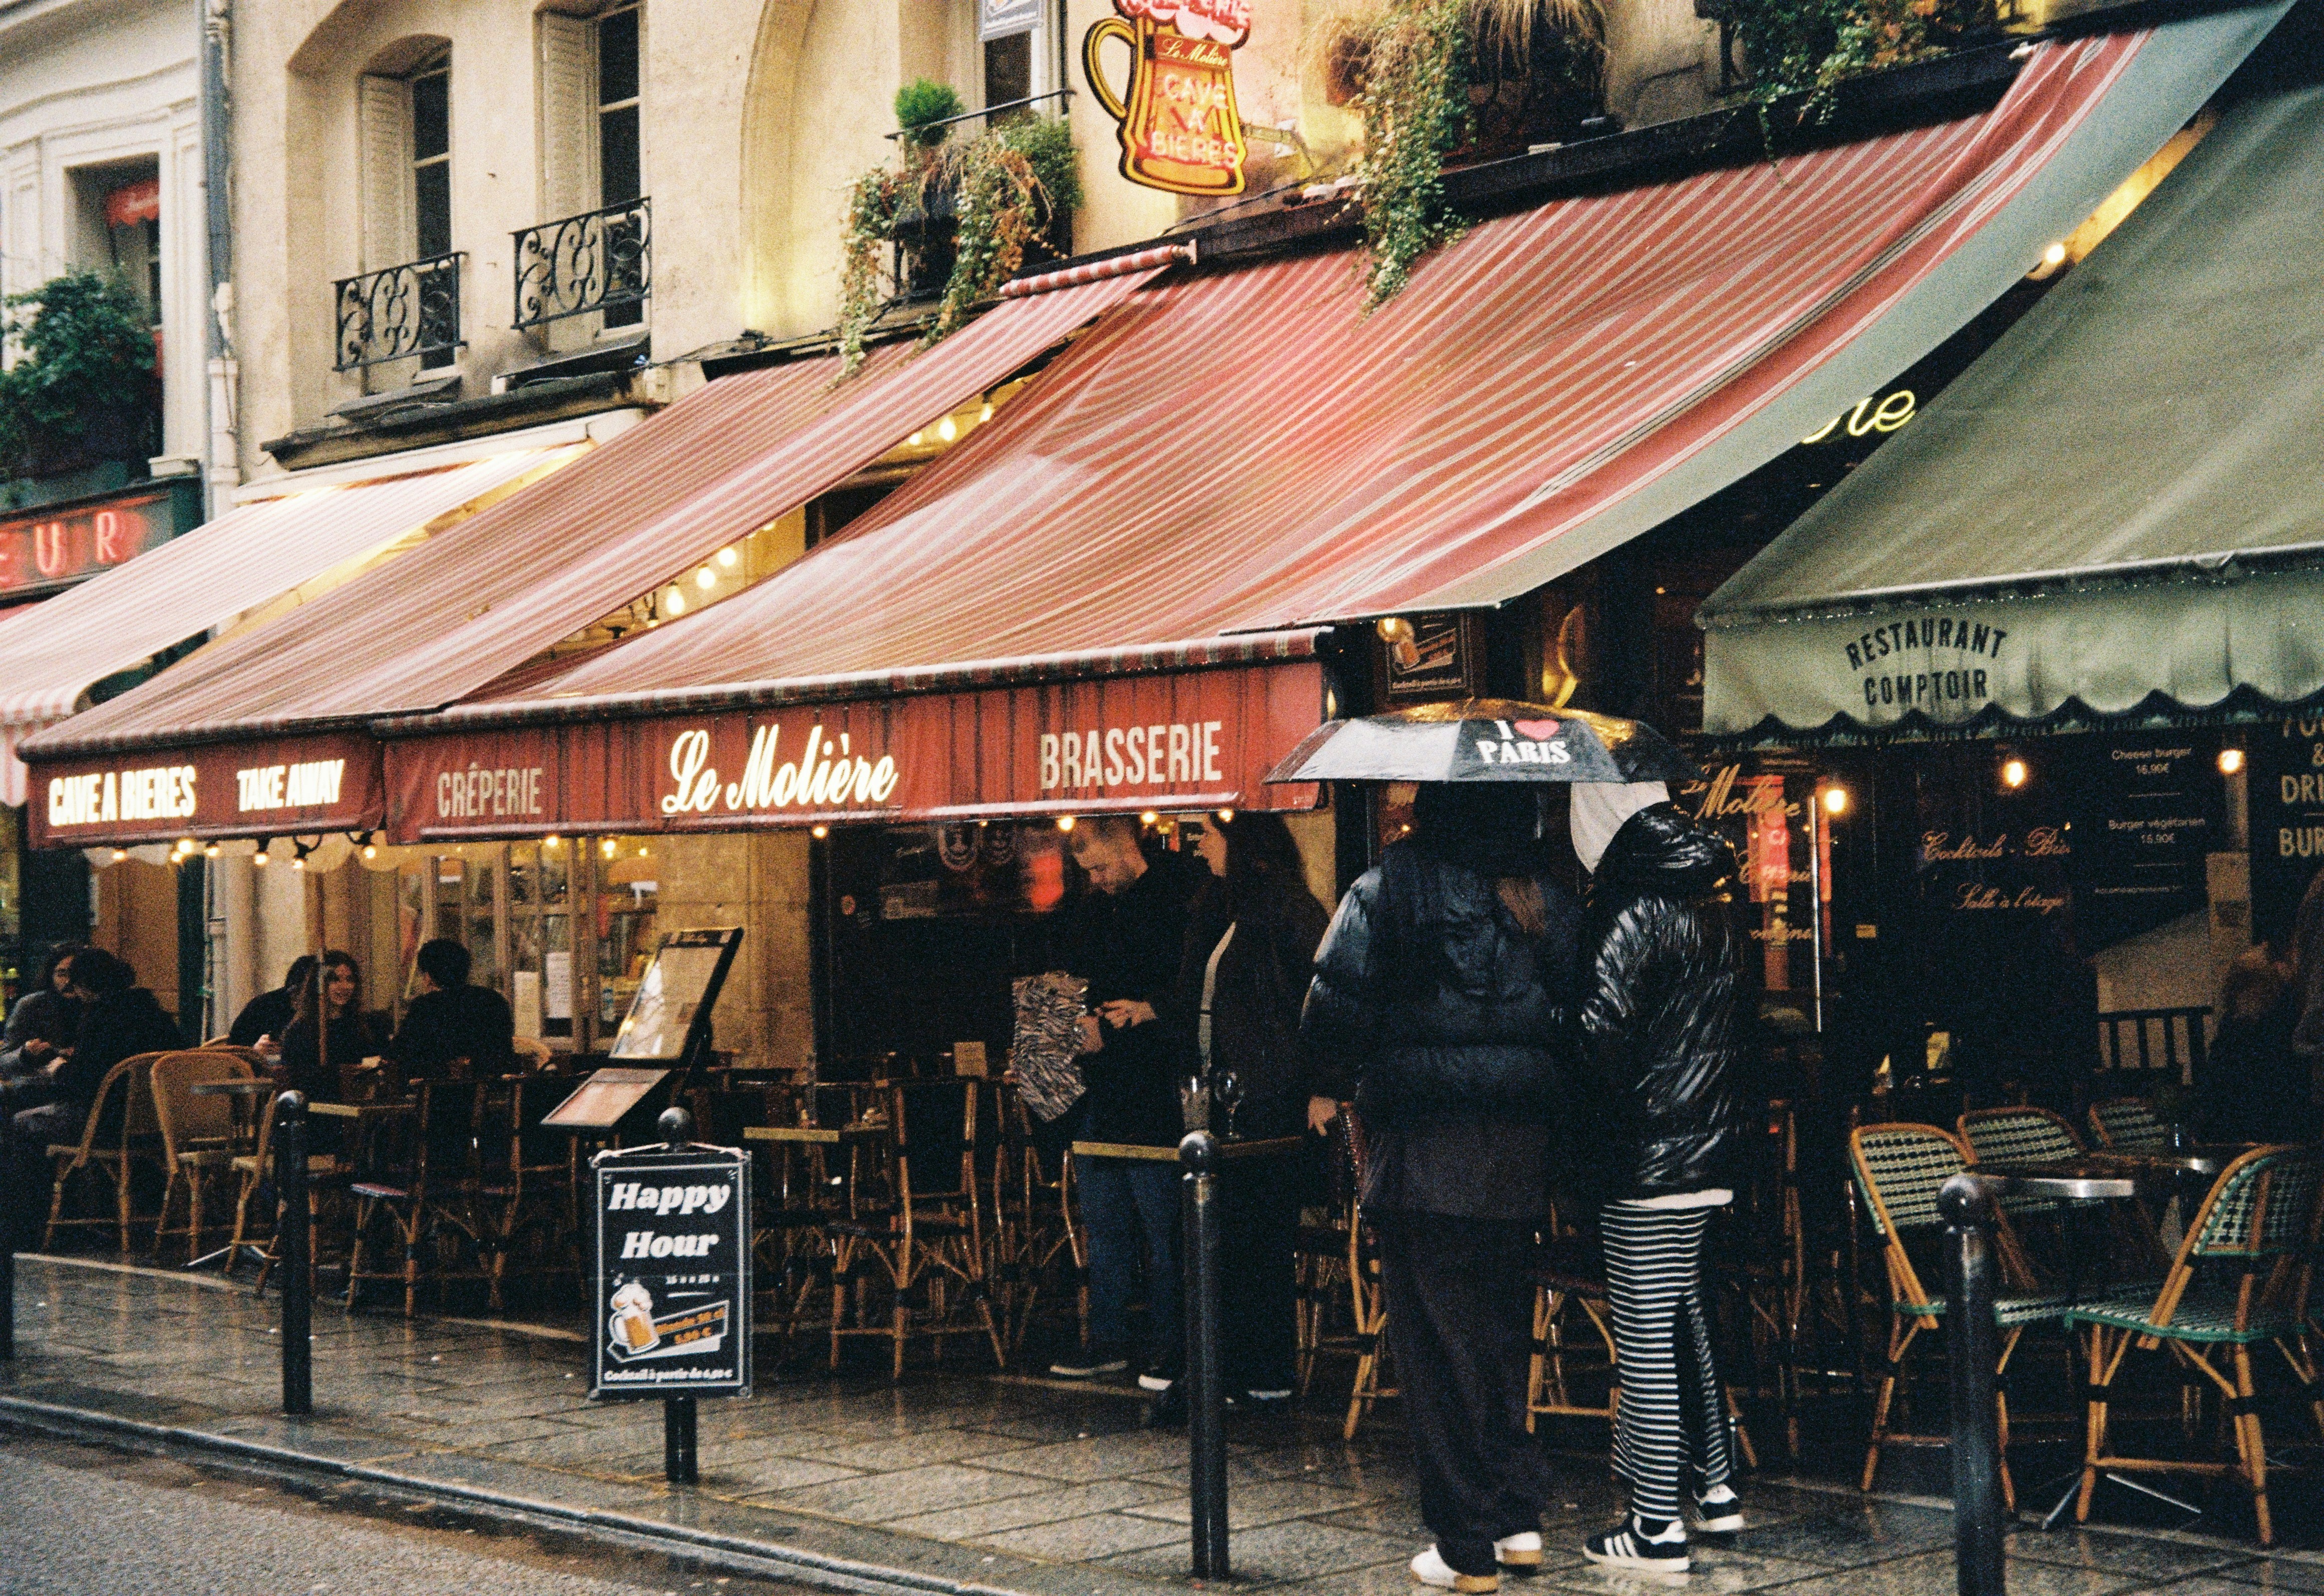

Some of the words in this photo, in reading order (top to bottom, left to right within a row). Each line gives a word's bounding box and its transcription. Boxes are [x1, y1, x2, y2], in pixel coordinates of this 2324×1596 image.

[1165, 74, 1228, 110] CAVE
[0, 510, 117, 585] UR
[1844, 618, 2007, 670] RESTAURANT
[1864, 668, 1988, 705] COMPTOIR
[1494, 719, 1514, 740] I
[661, 729, 722, 814] Le
[726, 723, 899, 810] Molière
[1041, 720, 1222, 789] BRASSERIE
[1476, 740, 1571, 764] PARIS
[2111, 748, 2153, 761] Cheese
[2154, 746, 2192, 760] burger
[49, 772, 101, 827] CAVE
[101, 772, 118, 822] A
[120, 765, 197, 821] BIERES
[237, 765, 286, 812] TAKE
[285, 759, 345, 807] AWAY
[437, 761, 543, 819] CRÊPERIE
[2108, 819, 2144, 832] Burger
[607, 1182, 731, 1216] Happy
[620, 1231, 720, 1259] Hour
